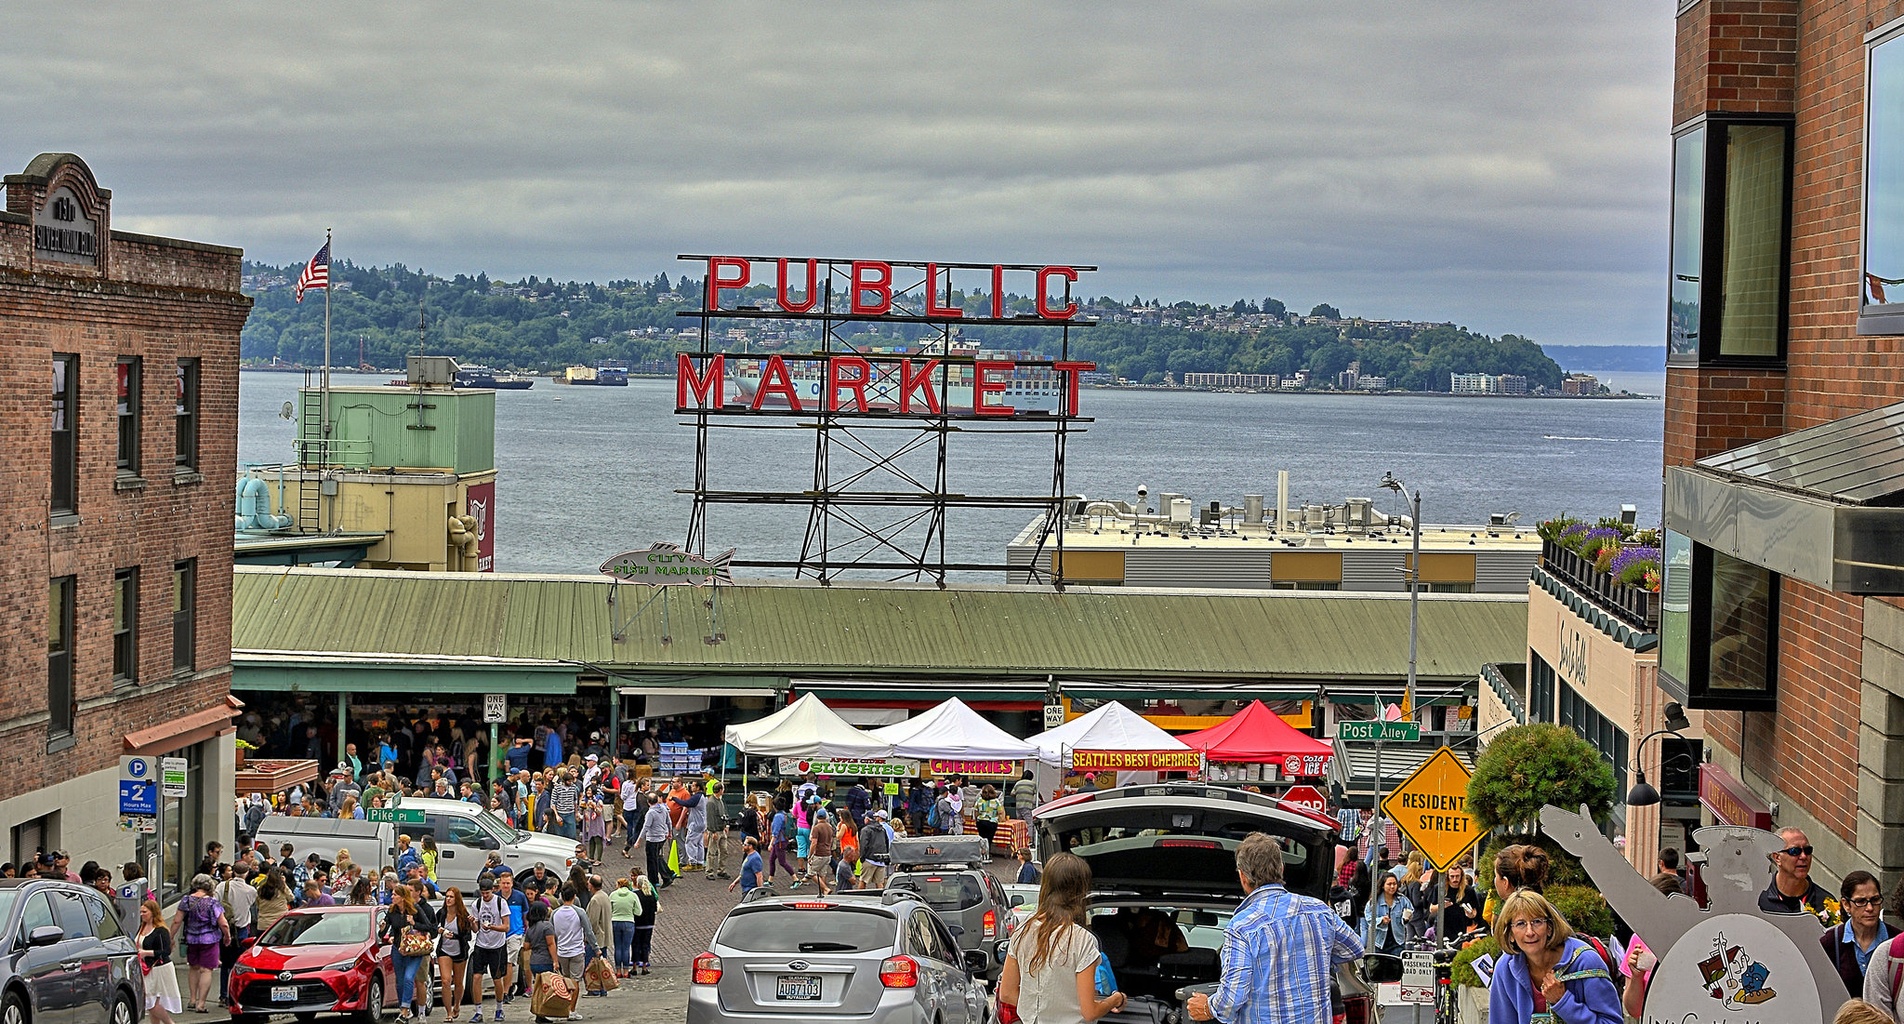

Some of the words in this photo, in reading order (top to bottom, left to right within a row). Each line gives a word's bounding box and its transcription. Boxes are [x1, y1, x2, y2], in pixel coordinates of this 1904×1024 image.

[708, 257, 1078, 320] PUBLIC
[677, 353, 1096, 416] MARKET
[648, 554, 688, 563] CITY
[613, 565, 649, 575] FISH
[655, 566, 718, 576] MARKET
[1343, 723, 1373, 737] Post
[1380, 729, 1407, 740] Alley
[931, 759, 1013, 774] CHERRIES
[1073, 753, 1122, 767] SEATTLES
[1124, 753, 1149, 767] BEST
[1152, 753, 1200, 767] CHERRIES
[134, 762, 143, 774] P
[810, 762, 905, 775] SLUSHIES
[1304, 762, 1320, 775] ICE
[132, 784, 146, 801] 2
[1402, 793, 1466, 811] RESIDENT
[371, 809, 393, 820] Pike
[399, 813, 407, 821] Pl
[1419, 815, 1469, 832] STREET
[780, 984, 818, 995] AUB7103
